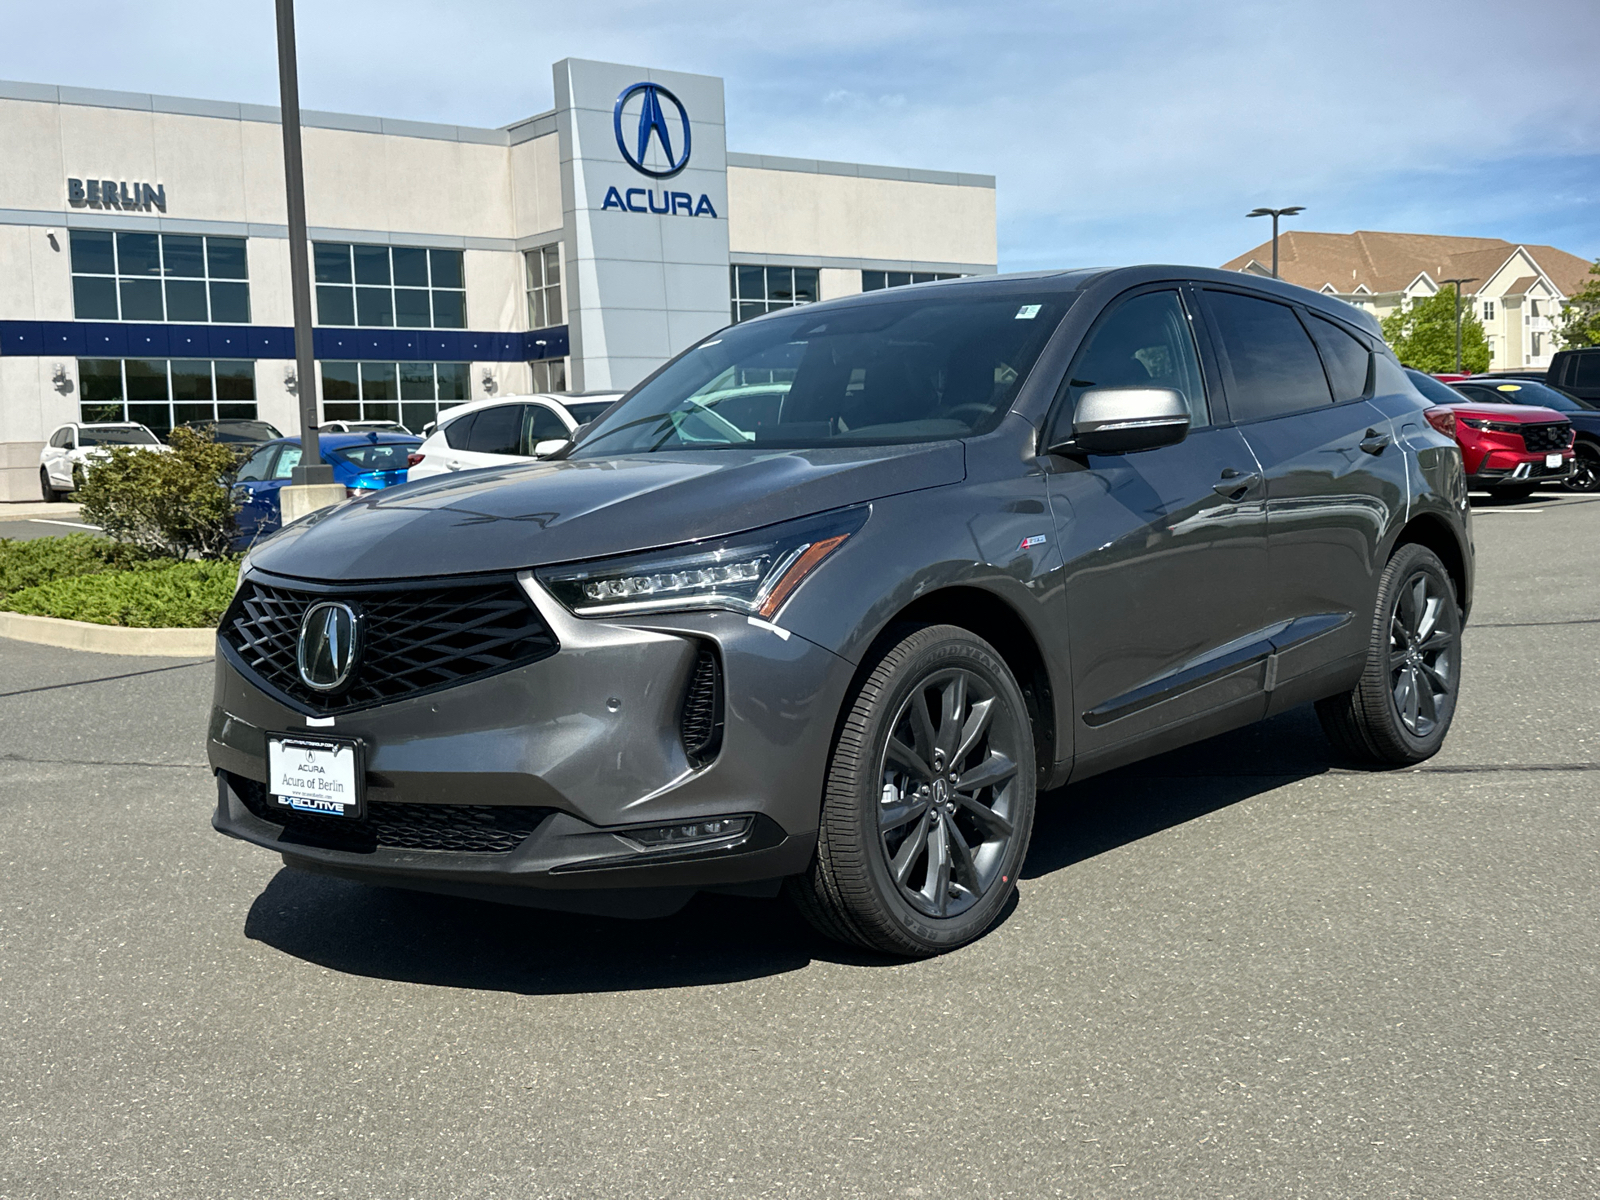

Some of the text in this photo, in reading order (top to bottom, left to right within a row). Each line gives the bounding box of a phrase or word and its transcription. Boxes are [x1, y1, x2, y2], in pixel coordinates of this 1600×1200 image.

[67, 178, 166, 209] BERLIN
[601, 186, 717, 218] ACURA
[298, 764, 325, 774] ACURA
[282, 774, 344, 792] Acura of Berlin
[278, 796, 344, 812] EXECUTIVE
